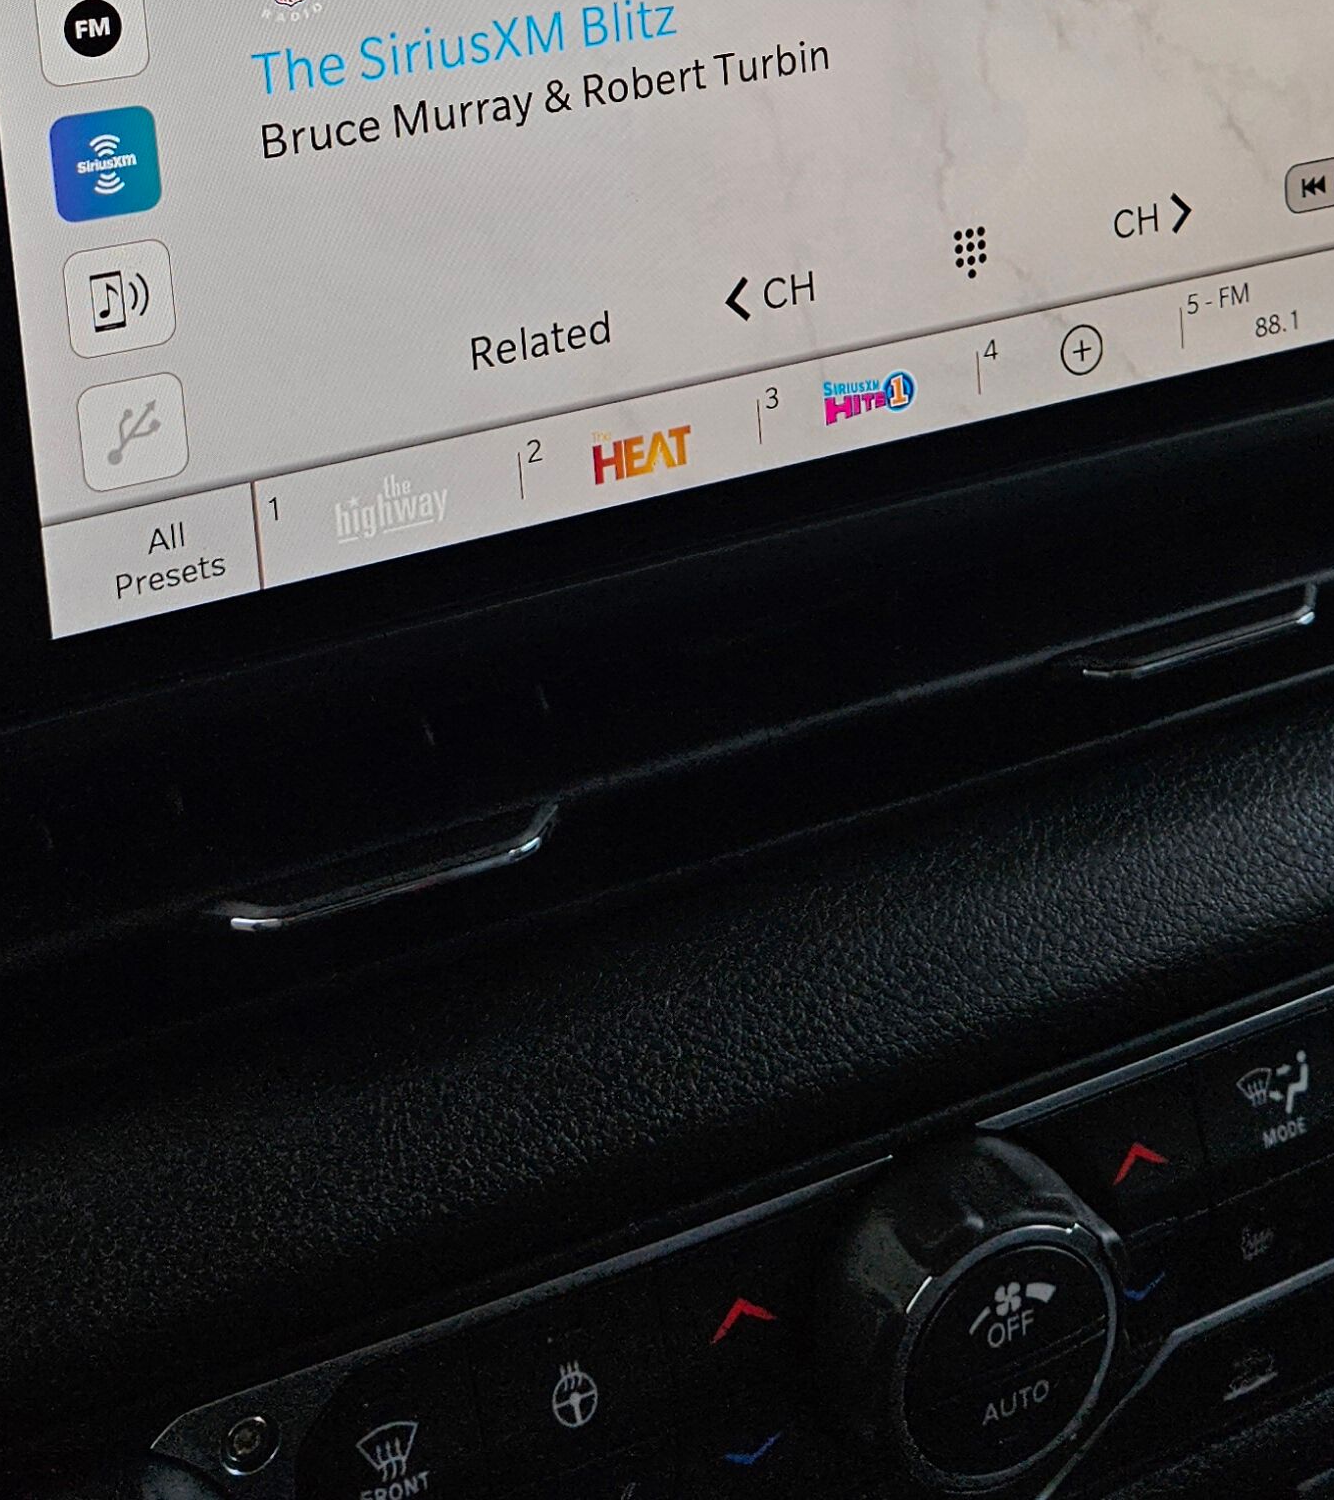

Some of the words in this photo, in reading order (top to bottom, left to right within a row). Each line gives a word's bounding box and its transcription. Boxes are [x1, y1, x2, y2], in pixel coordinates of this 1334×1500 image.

[74, 16, 111, 40] FM
[250, 47, 347, 98] The
[358, 11, 566, 82] SiriusXM
[259, 110, 382, 160] Bruce
[392, 86, 533, 141] Murray
[543, 78, 574, 114] &
[582, 59, 708, 108] Robert
[713, 38, 832, 87] Turbin
[1112, 207, 1160, 240] CH
[762, 273, 817, 311] CH
[1186, 292, 1200, 315] 5
[1217, 283, 1251, 310] FM
[470, 310, 615, 372] Related
[1254, 310, 1301, 340] 88.1
[982, 338, 999, 362] 4
[764, 387, 780, 410] 3
[823, 390, 887, 427] HITS
[525, 439, 543, 465] 2
[591, 424, 693, 487] HEAT
[383, 473, 413, 498] the
[267, 496, 279, 522] 1
[333, 487, 450, 543] highway
[146, 522, 187, 555] All
[114, 551, 227, 601] Presets
[1262, 1116, 1309, 1150] MODE
[985, 1308, 1037, 1351] OFF
[981, 1379, 1051, 1429] AUTO
